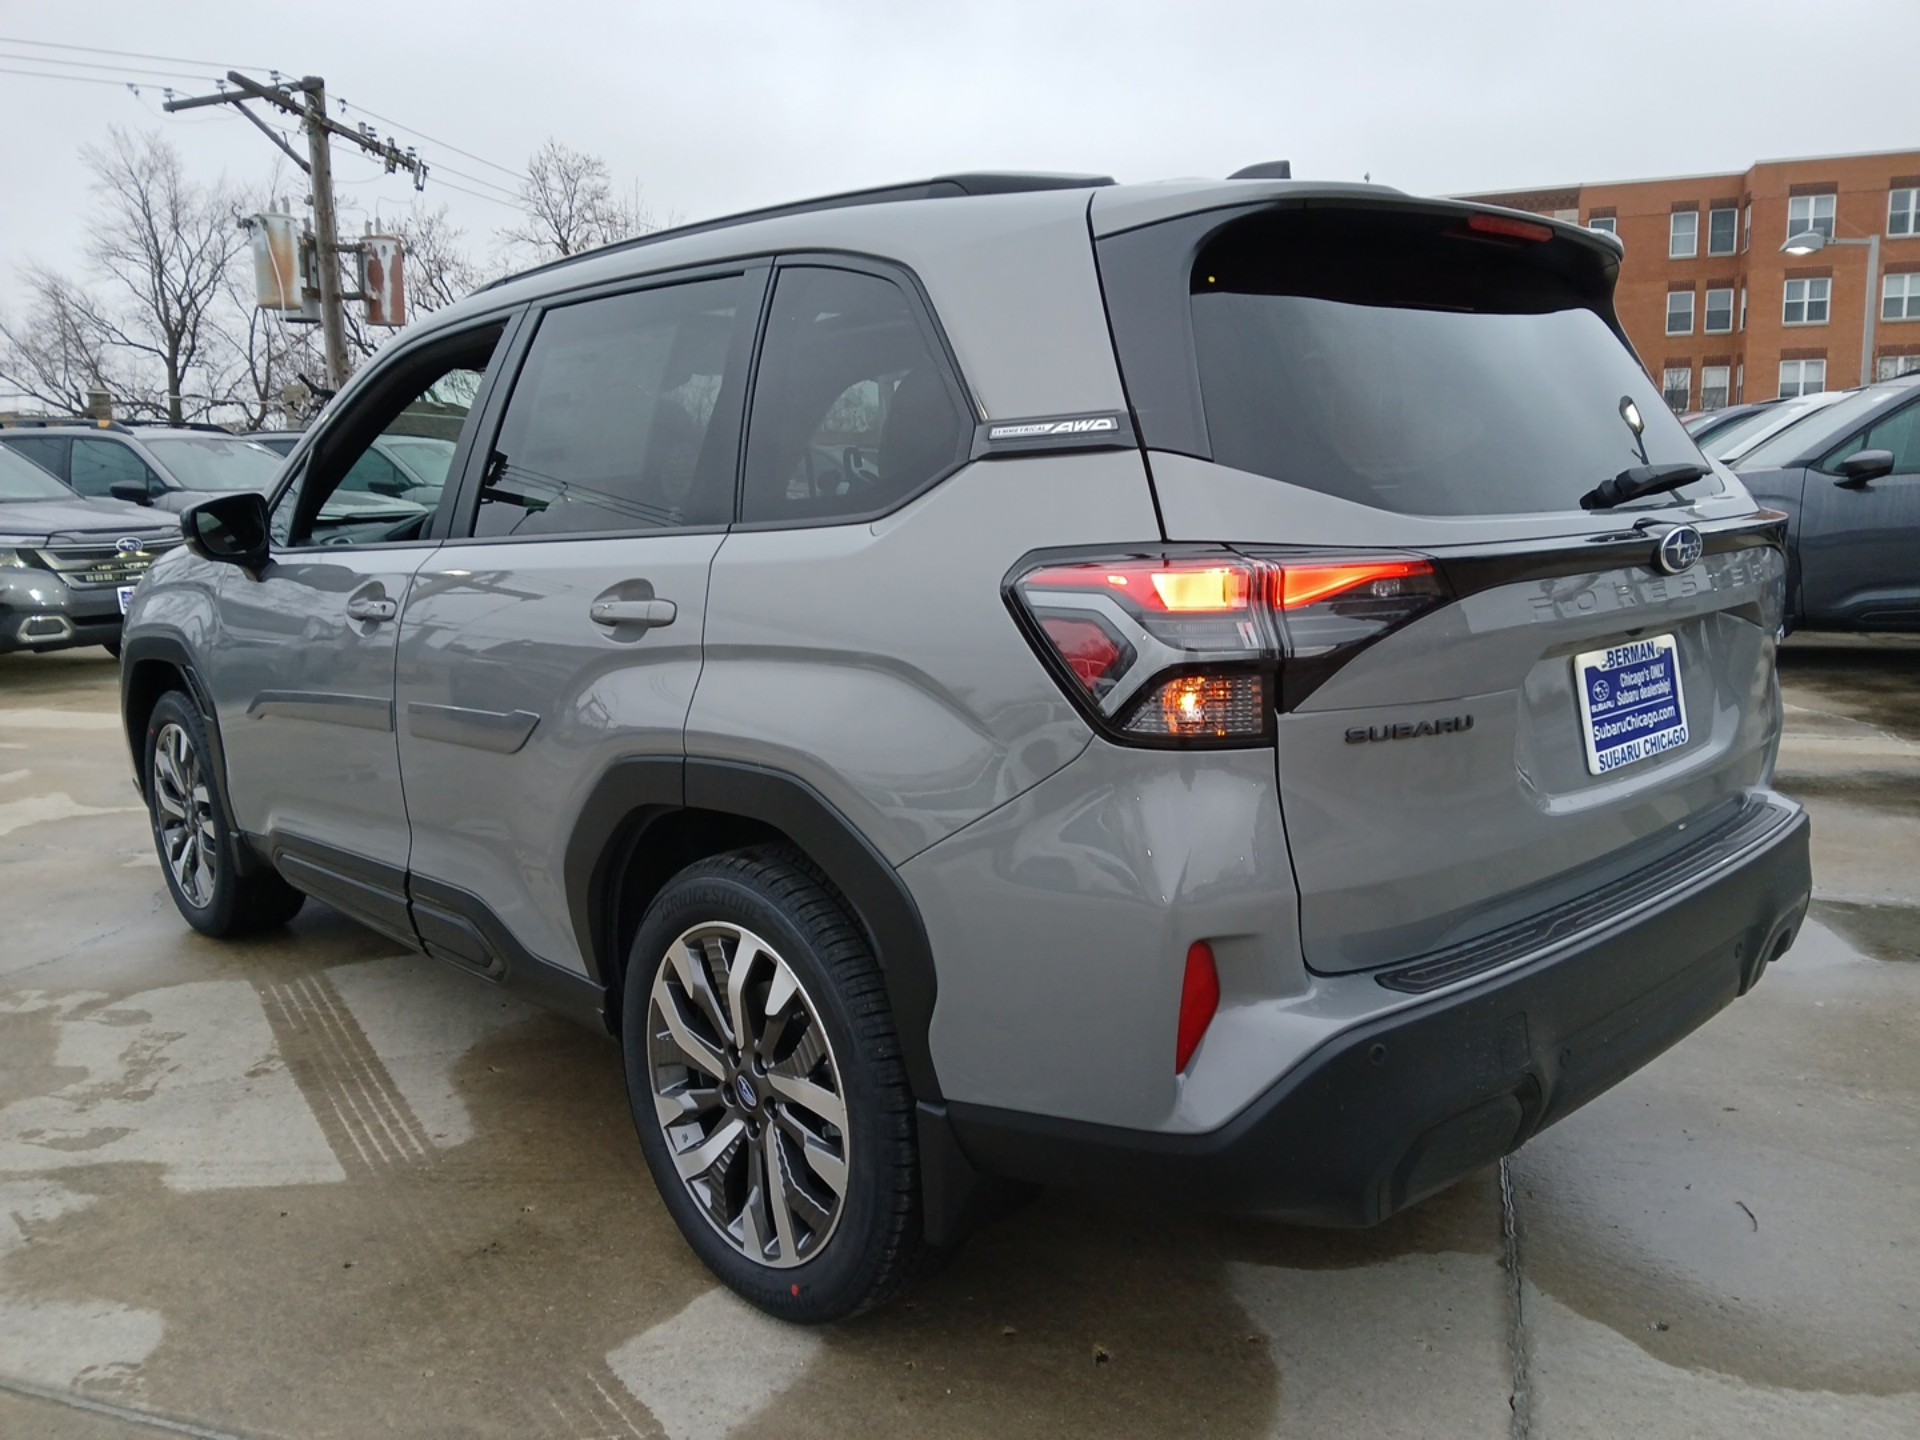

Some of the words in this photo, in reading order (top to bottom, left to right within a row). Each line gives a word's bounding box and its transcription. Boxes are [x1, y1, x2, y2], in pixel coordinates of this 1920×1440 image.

[1051, 418, 1112, 434] AWD
[1528, 563, 1765, 622] FORESTER
[1607, 641, 1655, 668] BERMAN
[1620, 667, 1650, 688] Chicago's
[1650, 662, 1665, 680] ONLY
[1591, 700, 1615, 713] SUBARU
[1616, 689, 1640, 706] Subaru
[1345, 714, 1474, 744] SUBARU
[1594, 705, 1675, 741] SubaruChicago.com
[1599, 742, 1641, 772] SUBARU
[1643, 727, 1686, 755] CHICAGO
[661, 883, 760, 922] BRIDGESTONE
